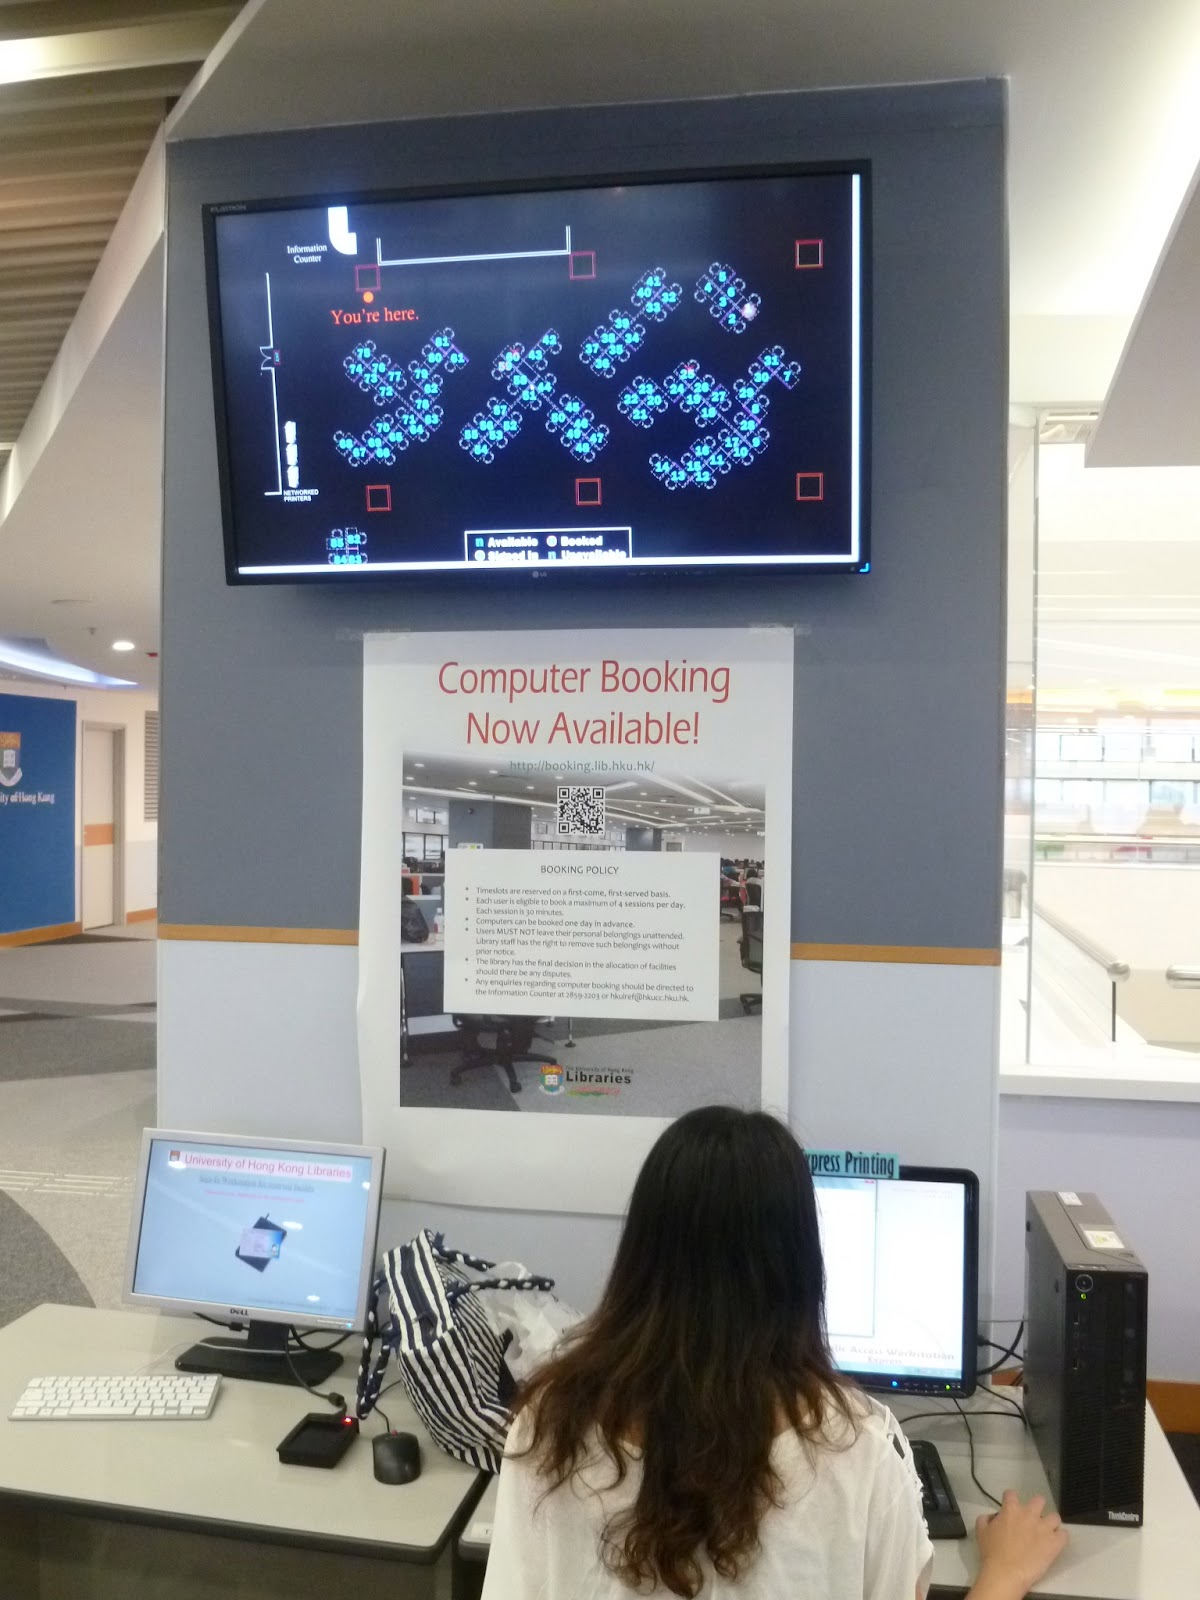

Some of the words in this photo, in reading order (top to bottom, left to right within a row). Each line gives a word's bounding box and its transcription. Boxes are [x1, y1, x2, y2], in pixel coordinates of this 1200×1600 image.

[287, 244, 327, 254] Information
[294, 254, 321, 263] Counter
[646, 277, 661, 286] 41
[704, 283, 712, 292] 4
[637, 288, 652, 298] 40
[331, 309, 380, 325] You're
[385, 308, 419, 322] here.
[542, 335, 557, 345] 42
[625, 333, 639, 344] 34
[585, 343, 599, 354] 37
[764, 355, 779, 365] 31
[349, 364, 363, 374] 74
[388, 371, 401, 381] 77
[754, 372, 769, 382] 30
[784, 370, 792, 381] 7
[379, 386, 393, 396] 72
[538, 382, 552, 392] 44
[639, 384, 654, 394] 23
[670, 384, 684, 394] 24
[632, 409, 648, 419] 21
[402, 415, 416, 424] 71
[725, 437, 740, 448] 17
[733, 447, 748, 457] 10
[655, 462, 670, 472] 14
[439, 662, 591, 703] Computer
[601, 660, 730, 703] Booking
[467, 712, 540, 744] Now
[548, 712, 699, 744] Available!
[510, 760, 655, 773] http://booking.lib.hku.hk/
[541, 865, 583, 873] BOOKING
[586, 866, 619, 874] POLICY
[568, 888, 606, 896] first-come,
[609, 889, 648, 897] first-served
[651, 890, 670, 898] basis.
[516, 898, 539, 907] eligible
[550, 898, 566, 906] book
[657, 902, 669, 910] per
[671, 901, 685, 910] day.
[476, 918, 513, 926] Computers
[528, 918, 536, 926] be
[538, 918, 563, 926] booked
[580, 920, 592, 928] day
[603, 920, 635, 928] advance.
[556, 929, 571, 937] their
[573, 930, 602, 938] personal
[604, 931, 640, 940] belongings
[476, 938, 499, 946] Library
[543, 940, 558, 948] right
[613, 942, 650, 950] belongings
[554, 960, 583, 968] decision
[542, 970, 572, 978] disputes.
[490, 979, 522, 987] enquiries
[524, 980, 556, 988] regarding
[592, 982, 620, 991] booking
[622, 982, 644, 990] should
[646, 983, 654, 991] be
[656, 984, 685, 992] directed
[488, 989, 528, 997] Information
[566, 992, 599, 1000] 2859-2203
[566, 1071, 631, 1084] Libraries
[185, 1154, 232, 1169] University
[236, 1160, 245, 1168] of
[248, 1160, 274, 1173] Hong
[278, 1162, 304, 1176] Kong
[308, 1165, 351, 1178] Libraries
[805, 1153, 840, 1173] xpress
[845, 1151, 894, 1179] Printing
[230, 1308, 248, 1316] DELL
[887, 1349, 955, 1360] Workstation
